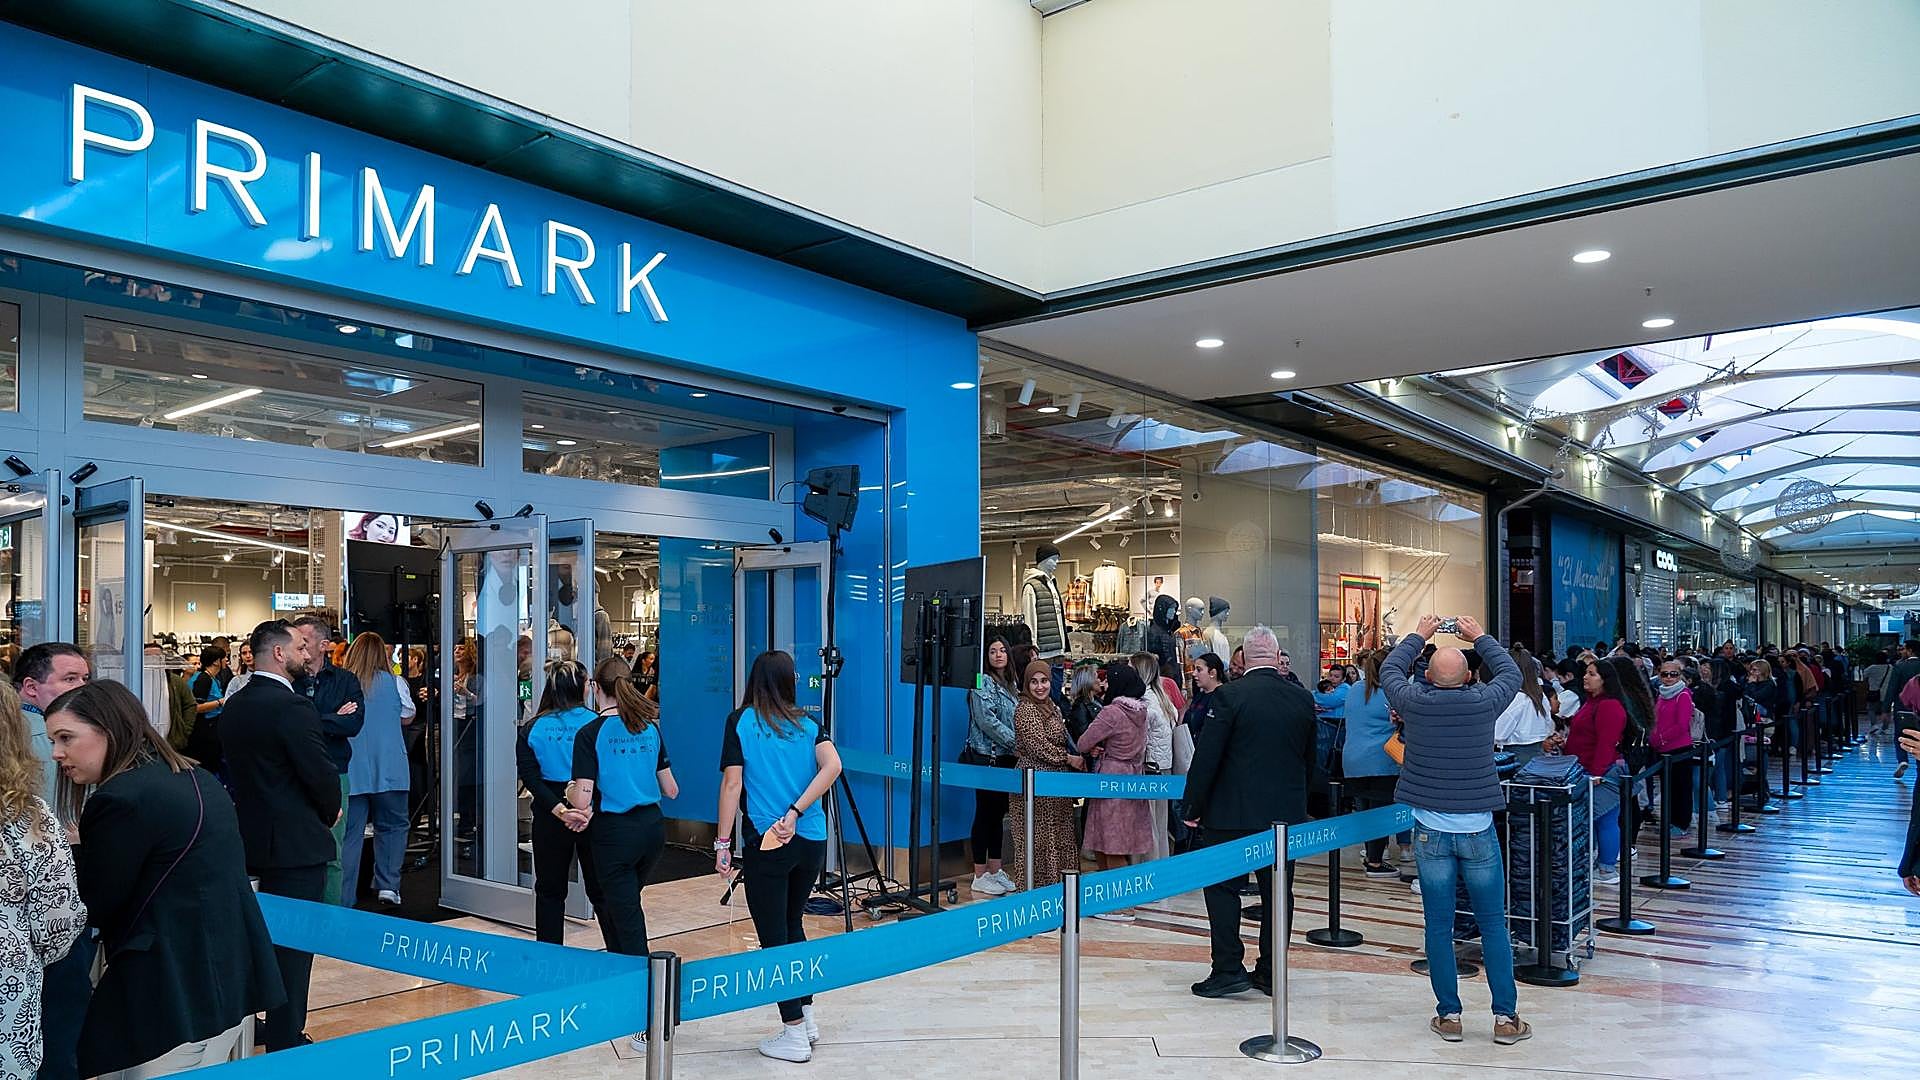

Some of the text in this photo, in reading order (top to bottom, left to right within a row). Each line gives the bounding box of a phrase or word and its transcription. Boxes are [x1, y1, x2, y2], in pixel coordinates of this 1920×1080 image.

[68, 83, 669, 323] PRIMARK
[894, 761, 944, 779] PRIA
[1100, 780, 1169, 793] PRIMARK
[1288, 826, 1337, 850] PRIMARK
[1084, 873, 1155, 905] PRIMARK
[977, 895, 1065, 938] PRIMARK
[381, 932, 491, 974] PRIMARK
[690, 954, 825, 1004] PRIMARK
[389, 1003, 581, 1077] PRIMARK
